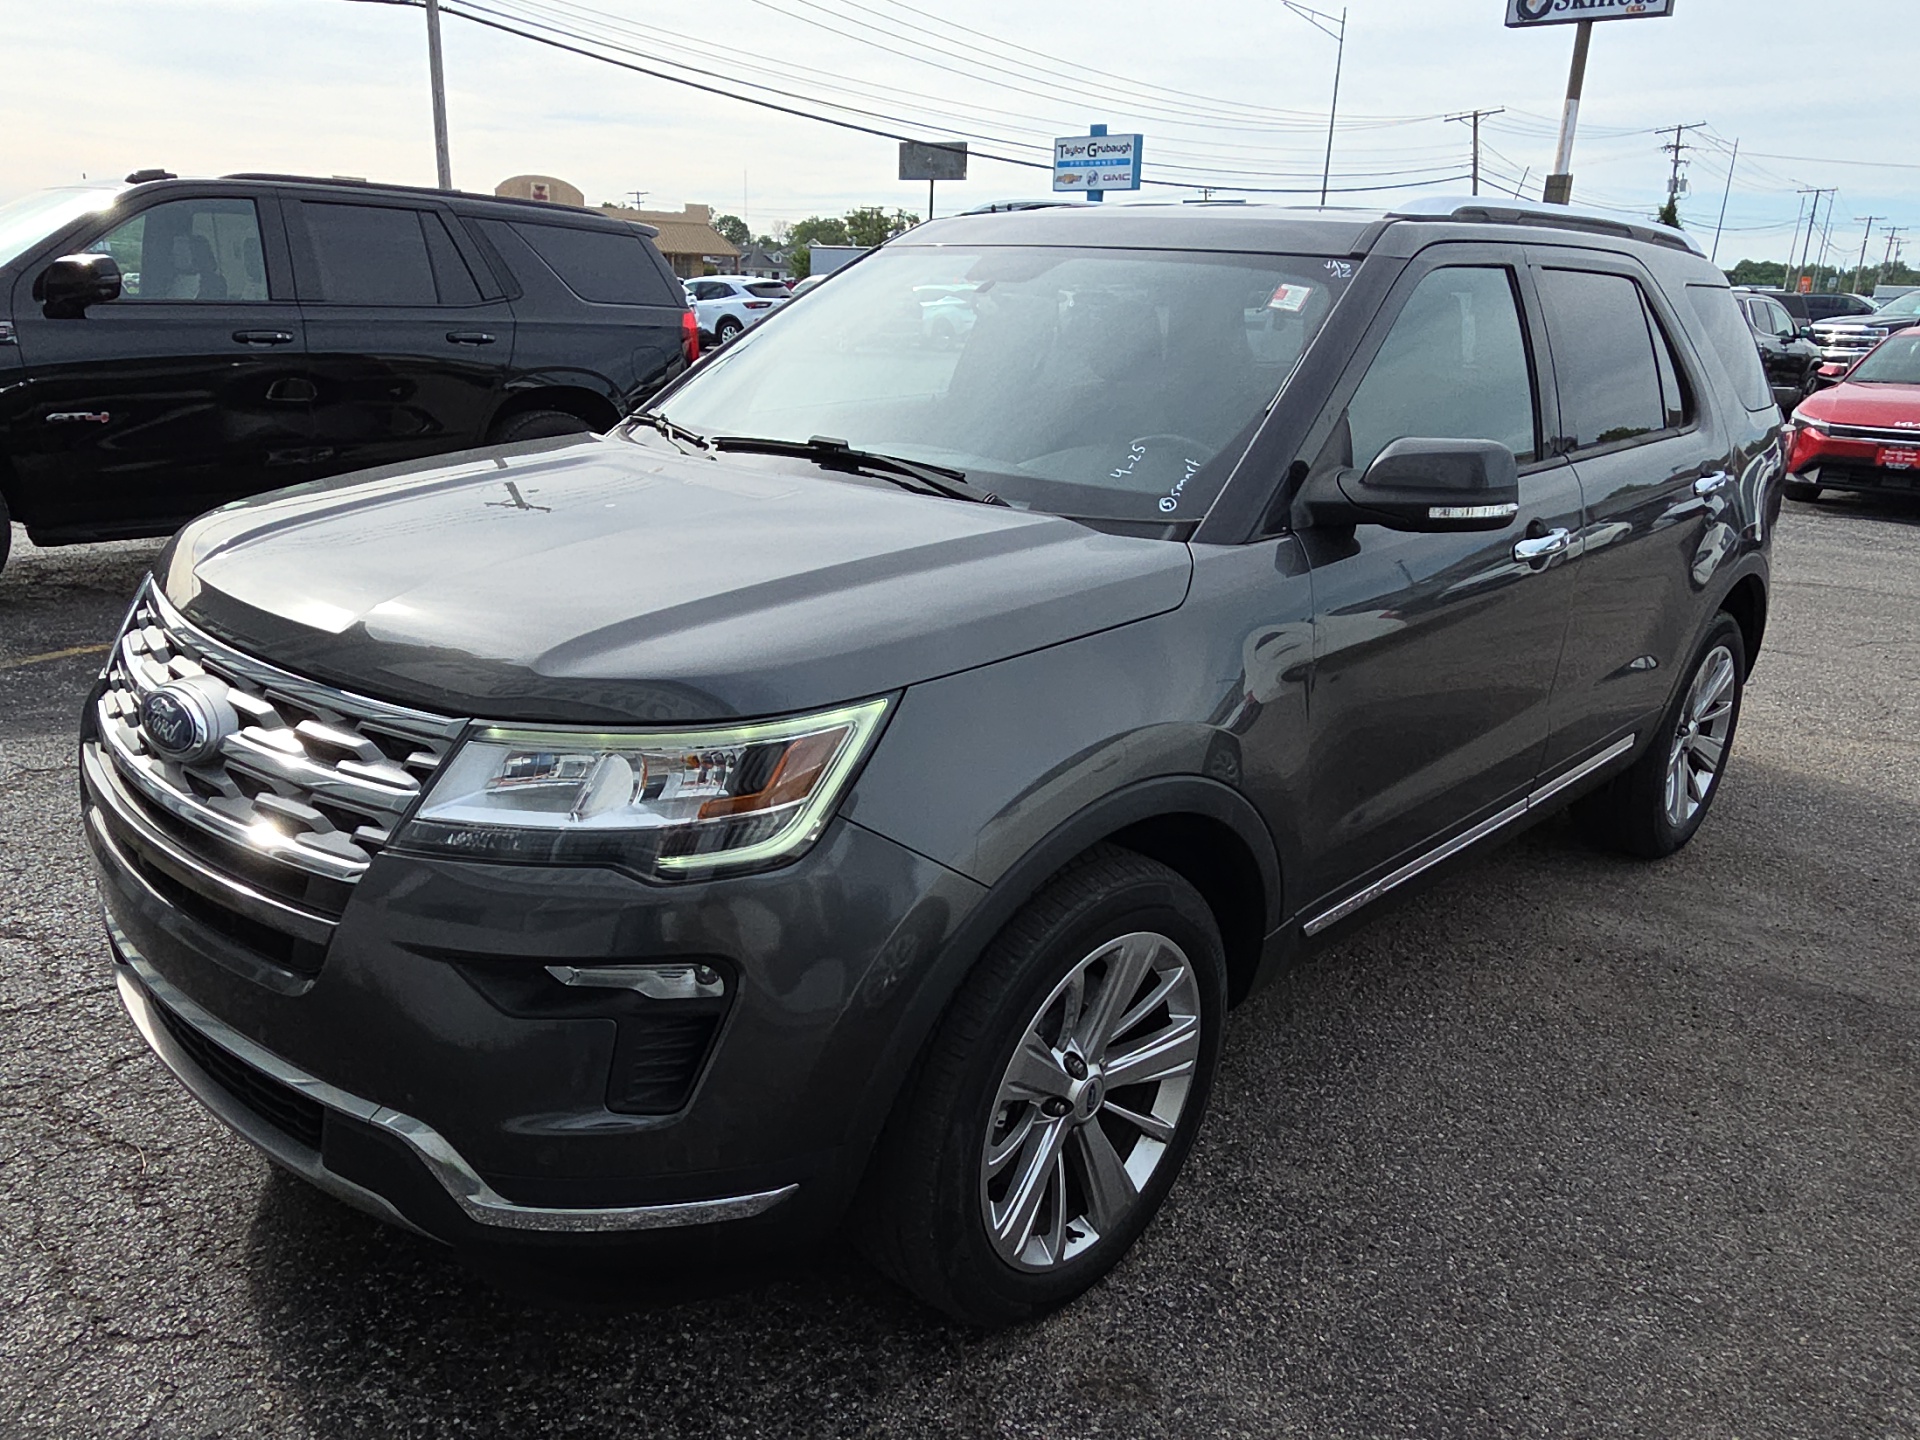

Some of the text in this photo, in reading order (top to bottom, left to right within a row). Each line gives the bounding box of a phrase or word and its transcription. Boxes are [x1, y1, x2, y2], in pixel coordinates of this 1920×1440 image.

[1058, 142, 1132, 159] Taylor Grubaugh
[1102, 172, 1131, 181] GMC
[145, 696, 182, 743] Ford
